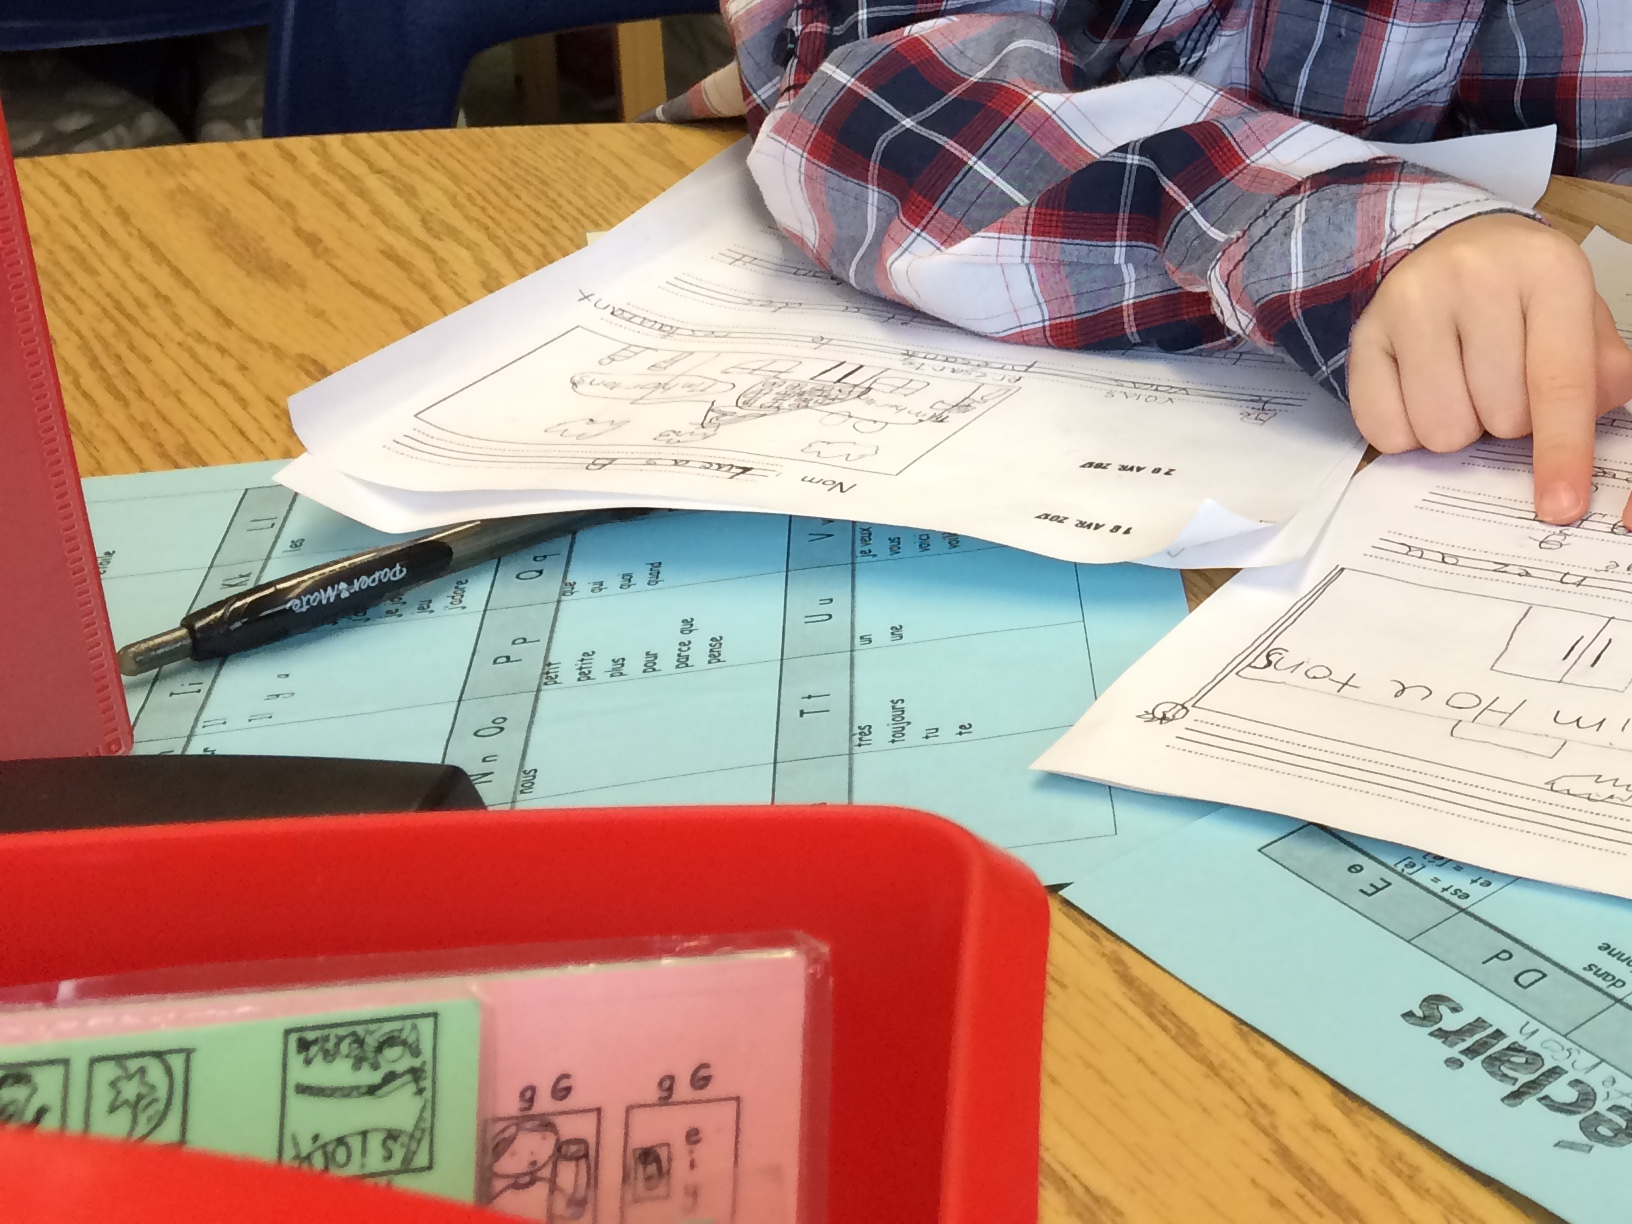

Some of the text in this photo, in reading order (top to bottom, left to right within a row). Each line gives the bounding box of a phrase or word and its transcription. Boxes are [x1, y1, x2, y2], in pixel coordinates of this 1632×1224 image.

[799, 474, 859, 494] Nom
[281, 538, 306, 554] les
[856, 525, 878, 559] je veux
[887, 535, 902, 556] vous
[914, 533, 931, 553] voici
[618, 571, 637, 591] quoi
[645, 561, 665, 588] quand
[442, 578, 470, 611] j'adore
[561, 580, 581, 597] que
[590, 580, 609, 595] qui
[804, 612, 834, 625] U
[675, 616, 699, 670] parce que
[858, 633, 873, 646] un
[890, 624, 904, 642] une
[707, 634, 727, 666] pense
[576, 649, 597, 683] petite
[604, 656, 629, 679] plus
[642, 650, 662, 674] pour
[543, 661, 563, 687] petit
[799, 708, 831, 718] T
[886, 697, 912, 745] toujours
[852, 723, 873, 748] très
[922, 726, 940, 740] tu
[955, 721, 973, 737] te
[519, 768, 539, 796] nous
[1441, 884, 1471, 900] est
[1469, 876, 1492, 888] et
[1581, 961, 1627, 993] dans
